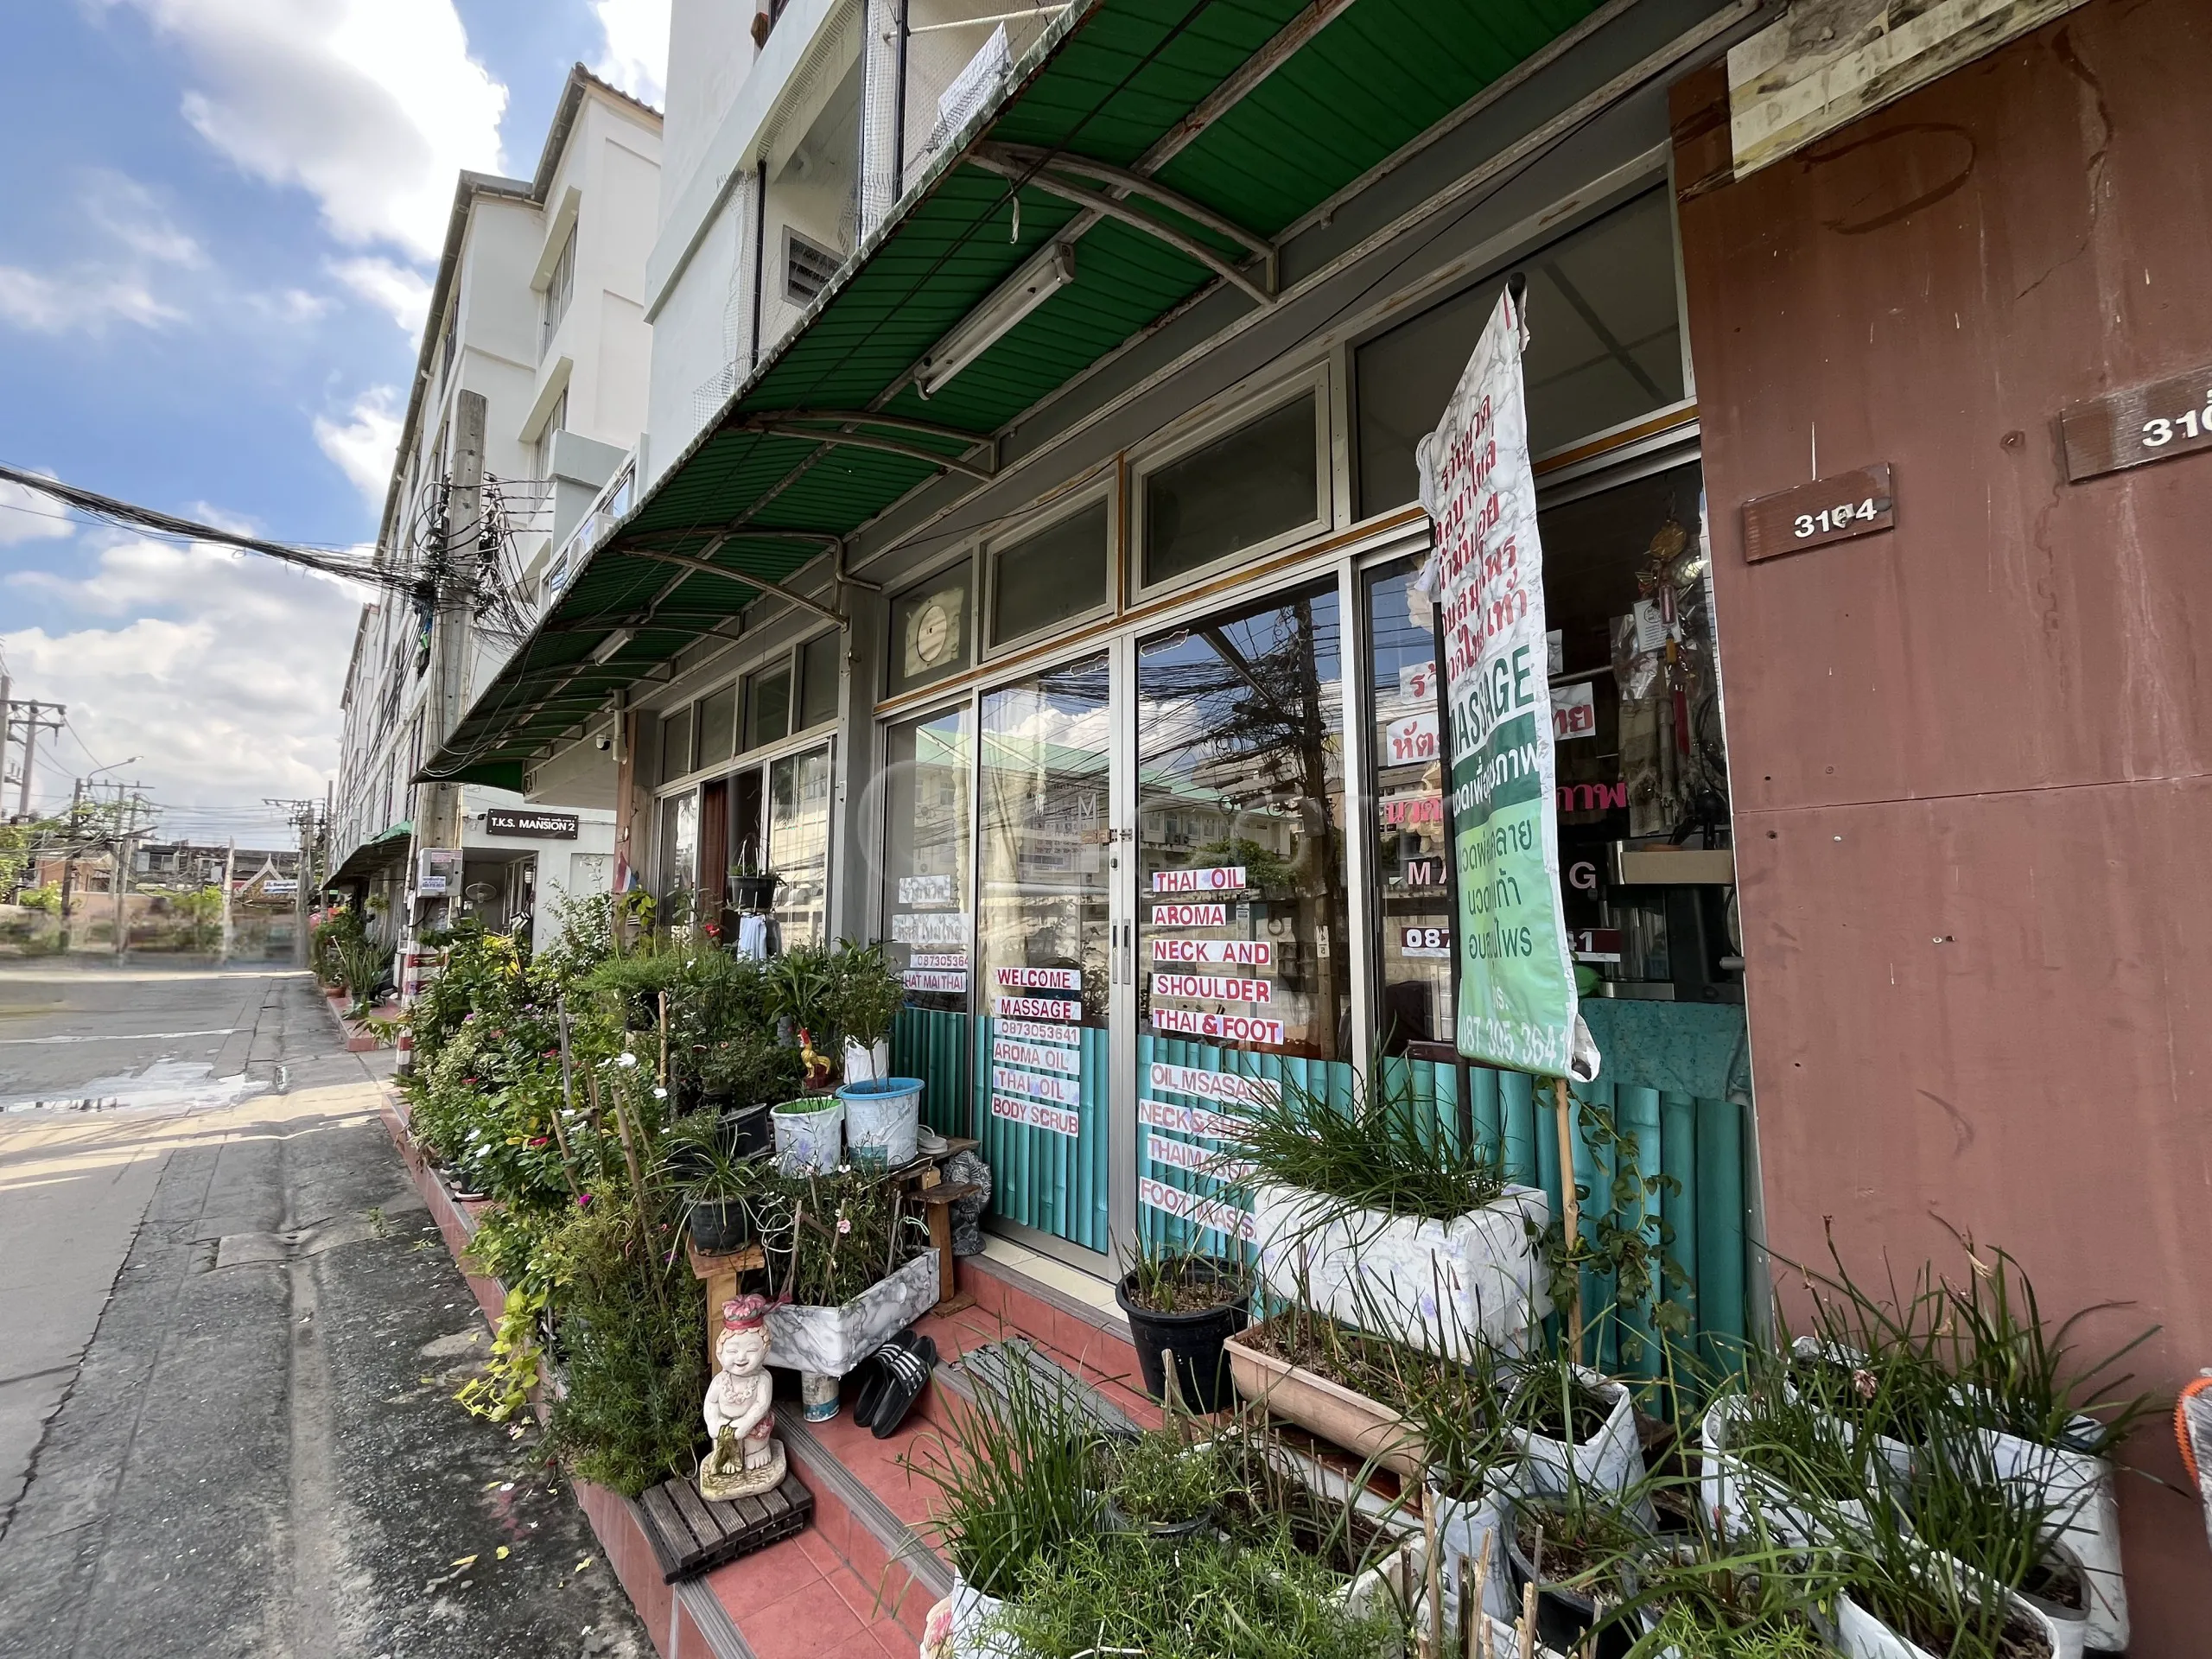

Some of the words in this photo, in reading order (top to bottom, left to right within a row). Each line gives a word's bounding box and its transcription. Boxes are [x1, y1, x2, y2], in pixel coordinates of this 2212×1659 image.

[1393, 721, 1440, 760] หัต
[491, 817, 516, 828] T.K.S.
[518, 819, 567, 831] MANSION
[568, 823, 575, 832] 2
[1156, 871, 1198, 893] THAI
[1211, 868, 1245, 889] OIL
[1154, 906, 1224, 925] AROMA
[1154, 940, 1209, 962] NECK
[1223, 942, 1269, 964] AND
[942, 976, 963, 990] THAI
[997, 969, 1071, 989] WELCOME
[1157, 975, 1269, 1002] SHOULDER
[1001, 998, 1071, 1019] MASSAGE
[1001, 1020, 1077, 1042] 0873053641
[1154, 1009, 1198, 1033] THAI
[1202, 1014, 1218, 1035] &
[1223, 1016, 1280, 1044] FOOT
[1460, 1014, 1481, 1053] 087
[1486, 1018, 1515, 1061] 305
[1521, 1021, 1567, 1070] 3641
[994, 1042, 1040, 1065] AROMA
[1045, 1050, 1069, 1071] OIL
[998, 1071, 1031, 1093] THAI
[1039, 1078, 1065, 1100] OIL
[1151, 1064, 1179, 1089] OIL
[993, 1096, 1027, 1122] BODY
[1031, 1106, 1078, 1135] SCRUB
[1141, 1179, 1191, 1215] FOOT
[1195, 1198, 1256, 1239] MASS
